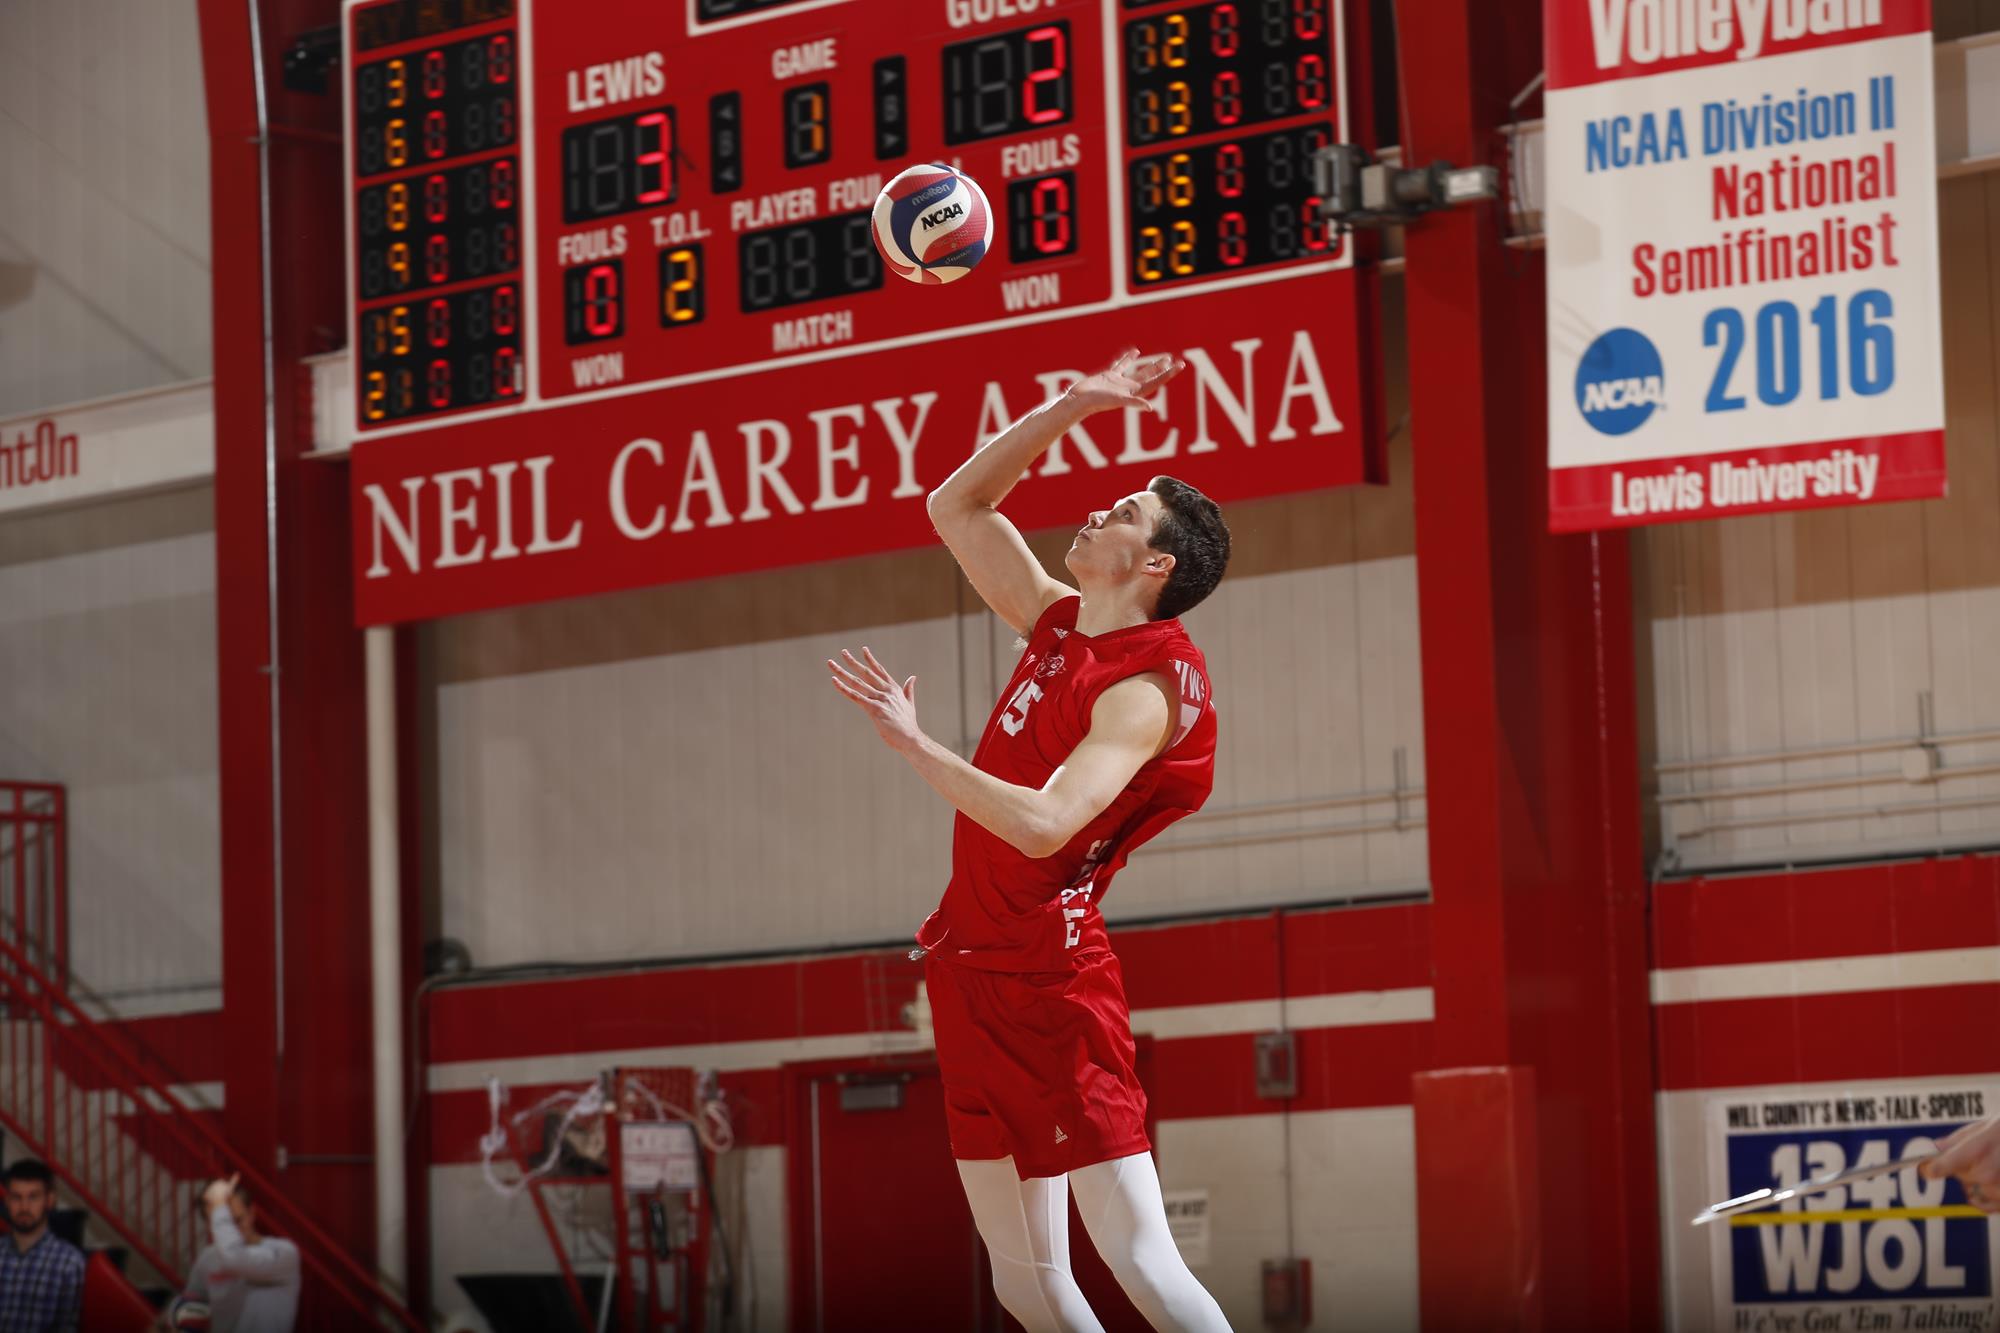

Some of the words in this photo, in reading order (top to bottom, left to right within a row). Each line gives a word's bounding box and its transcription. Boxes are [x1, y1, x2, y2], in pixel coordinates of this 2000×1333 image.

[388, 59, 406, 108] 3
[567, 52, 665, 112] LEWIS
[772, 38, 837, 80] GAME
[1023, 26, 1065, 124] 2
[1584, 107, 1688, 173] NCAA
[1702, 88, 1856, 155] Division
[1869, 75, 1895, 131] II
[636, 112, 672, 204] 3
[1002, 134, 1080, 178] FOULS
[1711, 141, 1896, 221] National
[731, 187, 816, 231] PLAYER
[911, 184, 950, 206] molten
[920, 202, 963, 231] NCAA
[1032, 178, 1070, 252] 0
[558, 225, 627, 265] FOULS
[651, 210, 711, 246] T.O.L.
[1632, 212, 1898, 298] Semifinalist
[585, 265, 616, 336] 0
[666, 250, 696, 321] 2
[1001, 274, 1060, 311] WON
[773, 310, 852, 352] MATCH
[1703, 288, 1895, 414] 2016
[572, 353, 624, 388] WON
[1583, 375, 1663, 413] NCAA
[363, 455, 582, 579] NEIL
[609, 392, 938, 540] CAREY
[1611, 466, 1702, 517] Lewis
[1709, 449, 1879, 506] University
[1726, 1105, 1759, 1128] WILL
[1763, 1100, 1831, 1125] COUNTY'S
[1835, 1098, 1876, 1123] NEWS
[1885, 1096, 1919, 1120] TALK
[1928, 1091, 1984, 1117] SPORTS
[1771, 1136, 1945, 1213] 1340
[1759, 1217, 1966, 1294] WJOL
[1735, 1308, 1797, 1332] We've
[1803, 1306, 1842, 1332] Got
[1850, 1306, 1892, 1330] 'Em
[1900, 1303, 1994, 1333] Talking!
